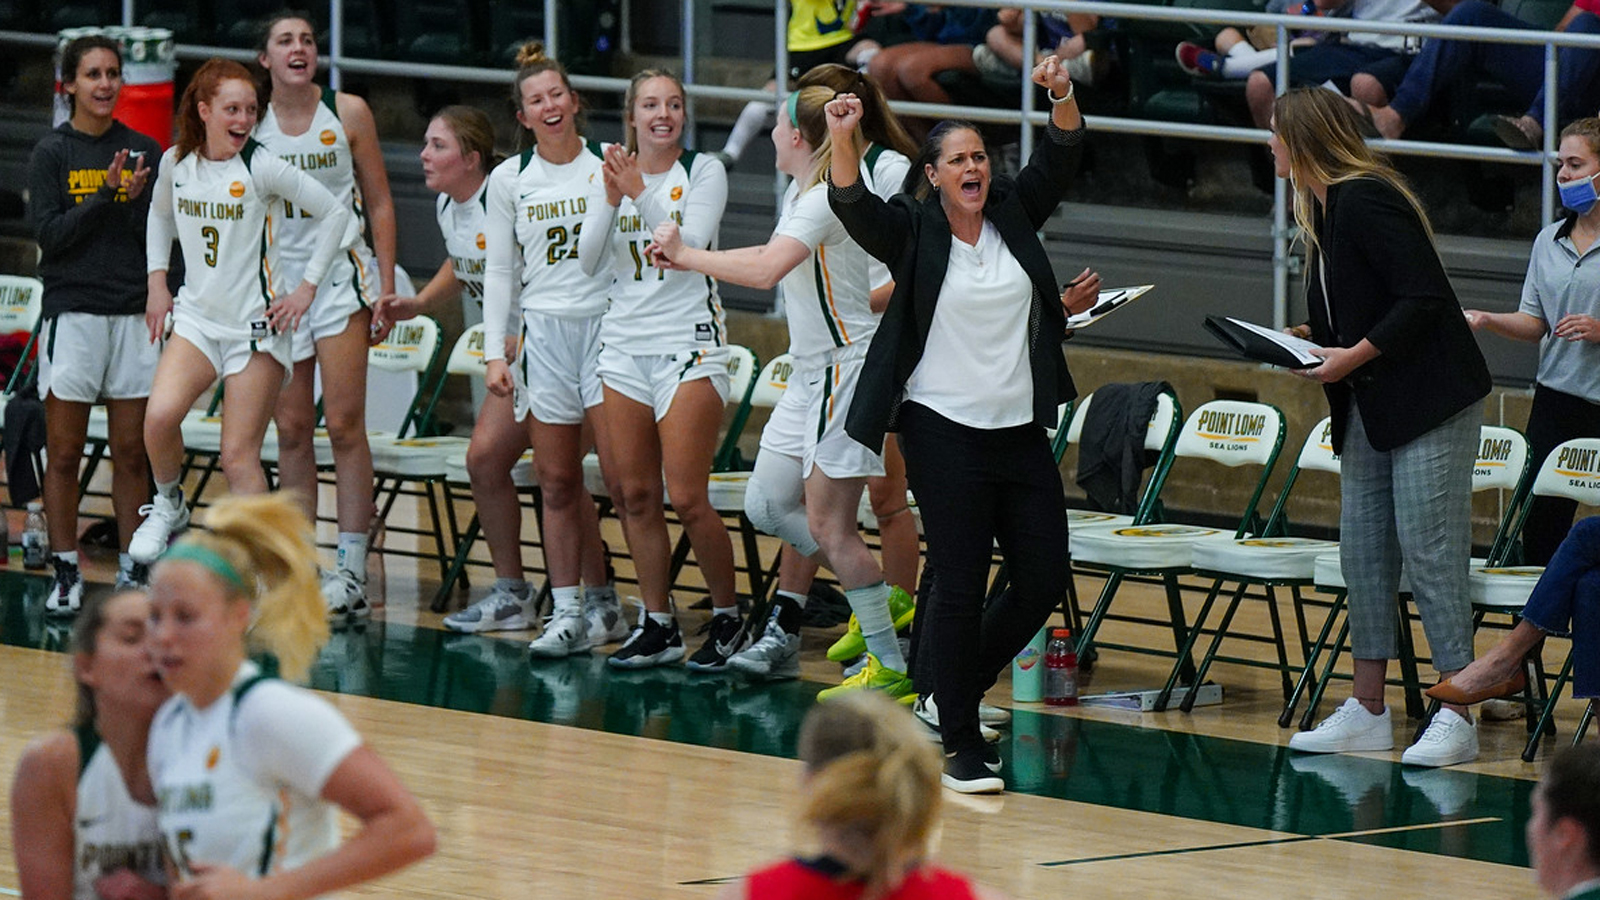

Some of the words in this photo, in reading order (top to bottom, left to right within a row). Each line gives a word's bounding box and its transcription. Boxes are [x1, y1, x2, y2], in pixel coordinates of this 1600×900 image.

[300, 151, 337, 170] LOMA
[178, 197, 207, 218] POINT
[210, 202, 244, 221] LOMA
[527, 200, 566, 223] POINT
[570, 197, 588, 215] LO
[615, 211, 647, 234] OIN
[202, 226, 219, 268] 3
[1197, 410, 1235, 435] POINT
[1235, 413, 1266, 436] LOMA
[1209, 442, 1225, 450] SEA
[1557, 447, 1598, 472] POINT
[1569, 480, 1586, 488] SEA
